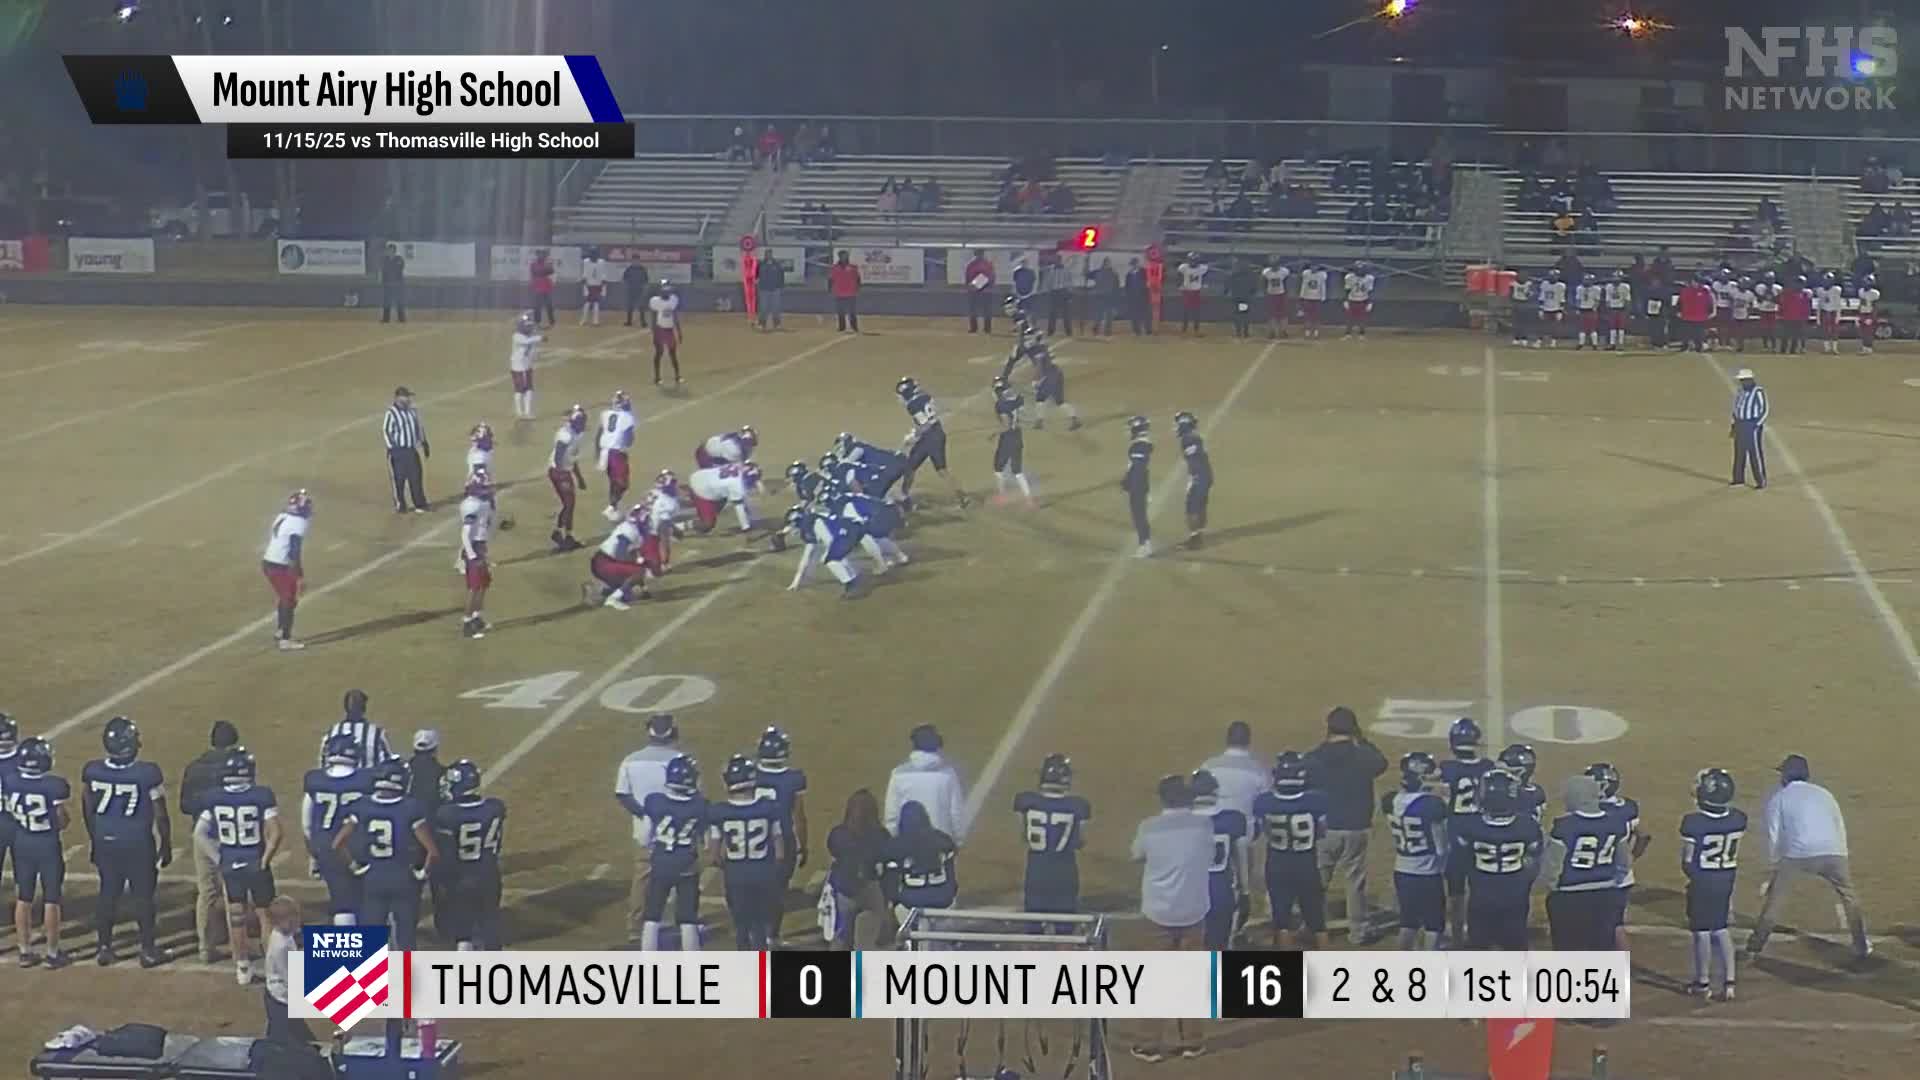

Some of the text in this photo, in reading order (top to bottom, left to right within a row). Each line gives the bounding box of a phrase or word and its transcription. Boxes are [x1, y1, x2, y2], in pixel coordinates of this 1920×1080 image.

[1084, 229, 1096, 247] 2
[456, 670, 717, 713] 40
[1367, 699, 1630, 735] 50
[4, 791, 51, 832] 42
[90, 780, 139, 816] 77
[315, 792, 364, 829] 7
[1453, 777, 1479, 814] 2
[213, 805, 262, 846] 66
[367, 819, 394, 857] 3
[458, 816, 500, 861] 54
[723, 818, 769, 861] 32
[1026, 809, 1075, 851] 67
[1265, 812, 1315, 851] 59
[1570, 834, 1617, 869] 64
[1700, 831, 1744, 869] 20
